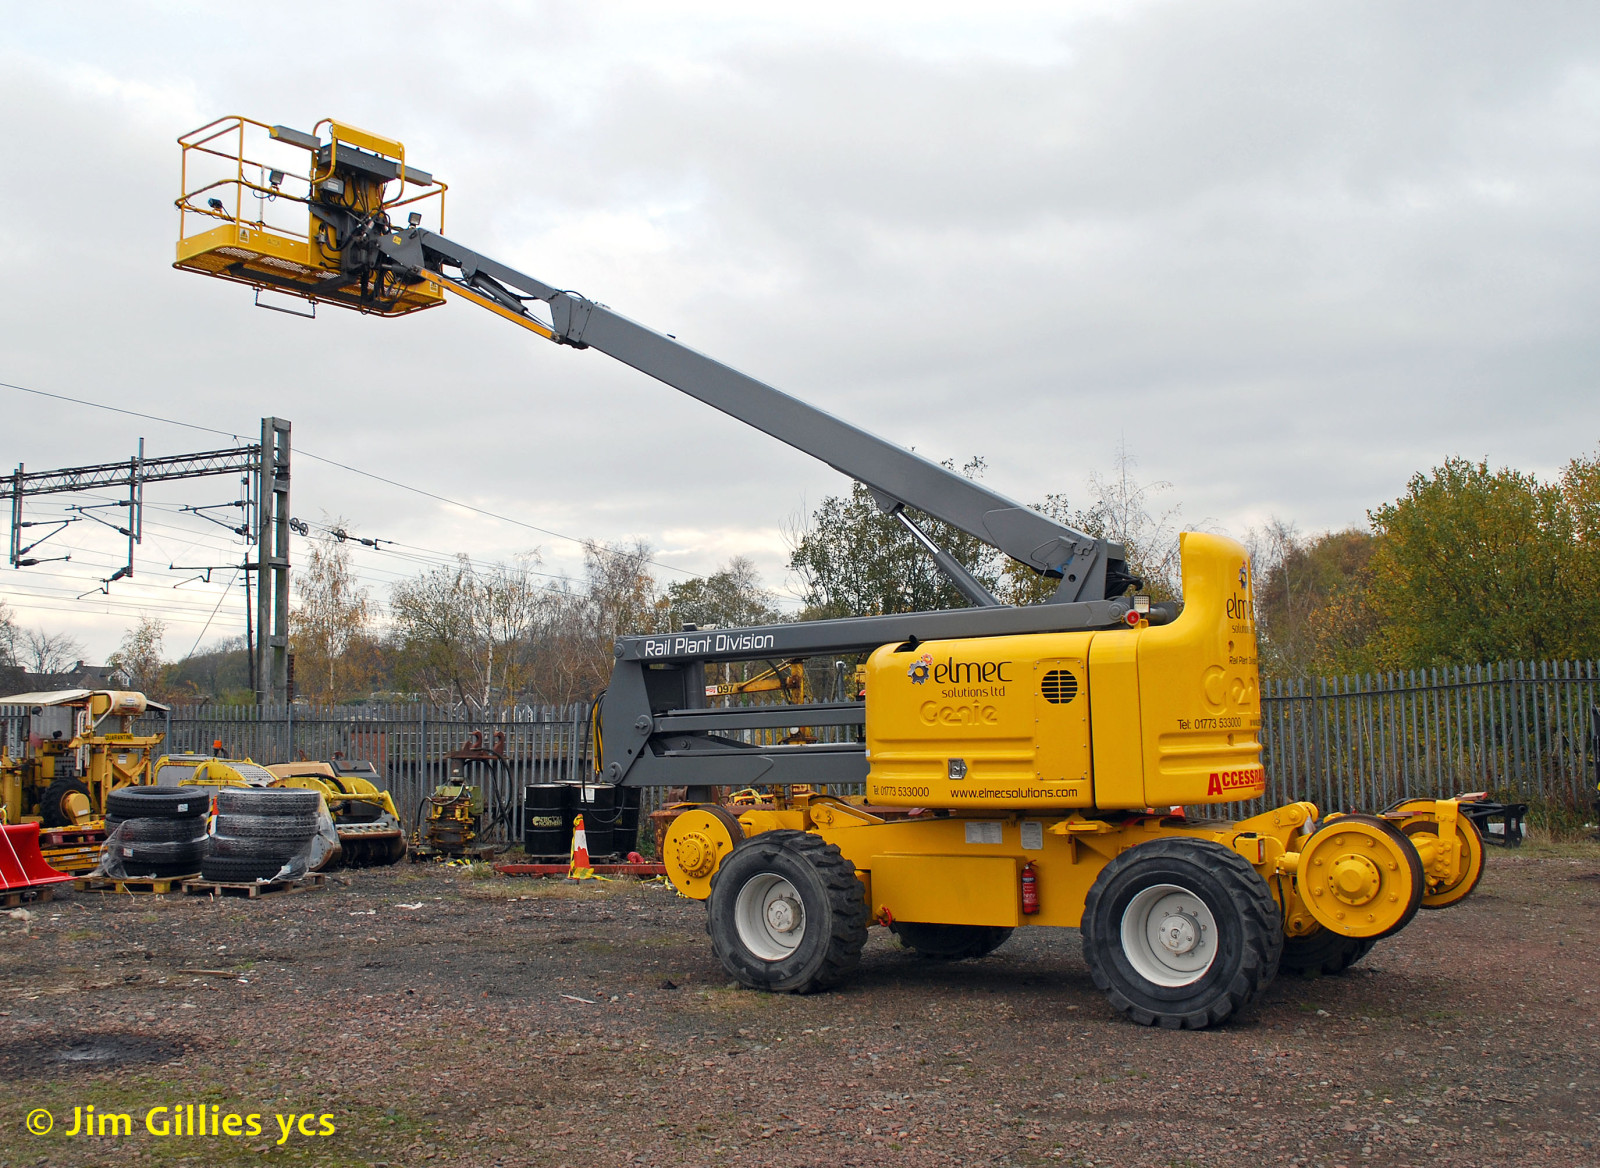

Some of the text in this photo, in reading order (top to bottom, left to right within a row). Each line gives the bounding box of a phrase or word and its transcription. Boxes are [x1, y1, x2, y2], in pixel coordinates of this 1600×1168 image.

[645, 633, 774, 657] Rail Plant Division
[934, 656, 1013, 684] elmec
[716, 684, 734, 694] 097
[941, 686, 1006, 698] solutions ltd
[920, 699, 998, 727] Genie
[1194, 718, 1217, 730] 01773
[1219, 717, 1242, 729] 533000
[880, 785, 897, 797] 01773
[898, 786, 930, 797] 533000
[950, 787, 1078, 799] www.elmecsolutions.com
